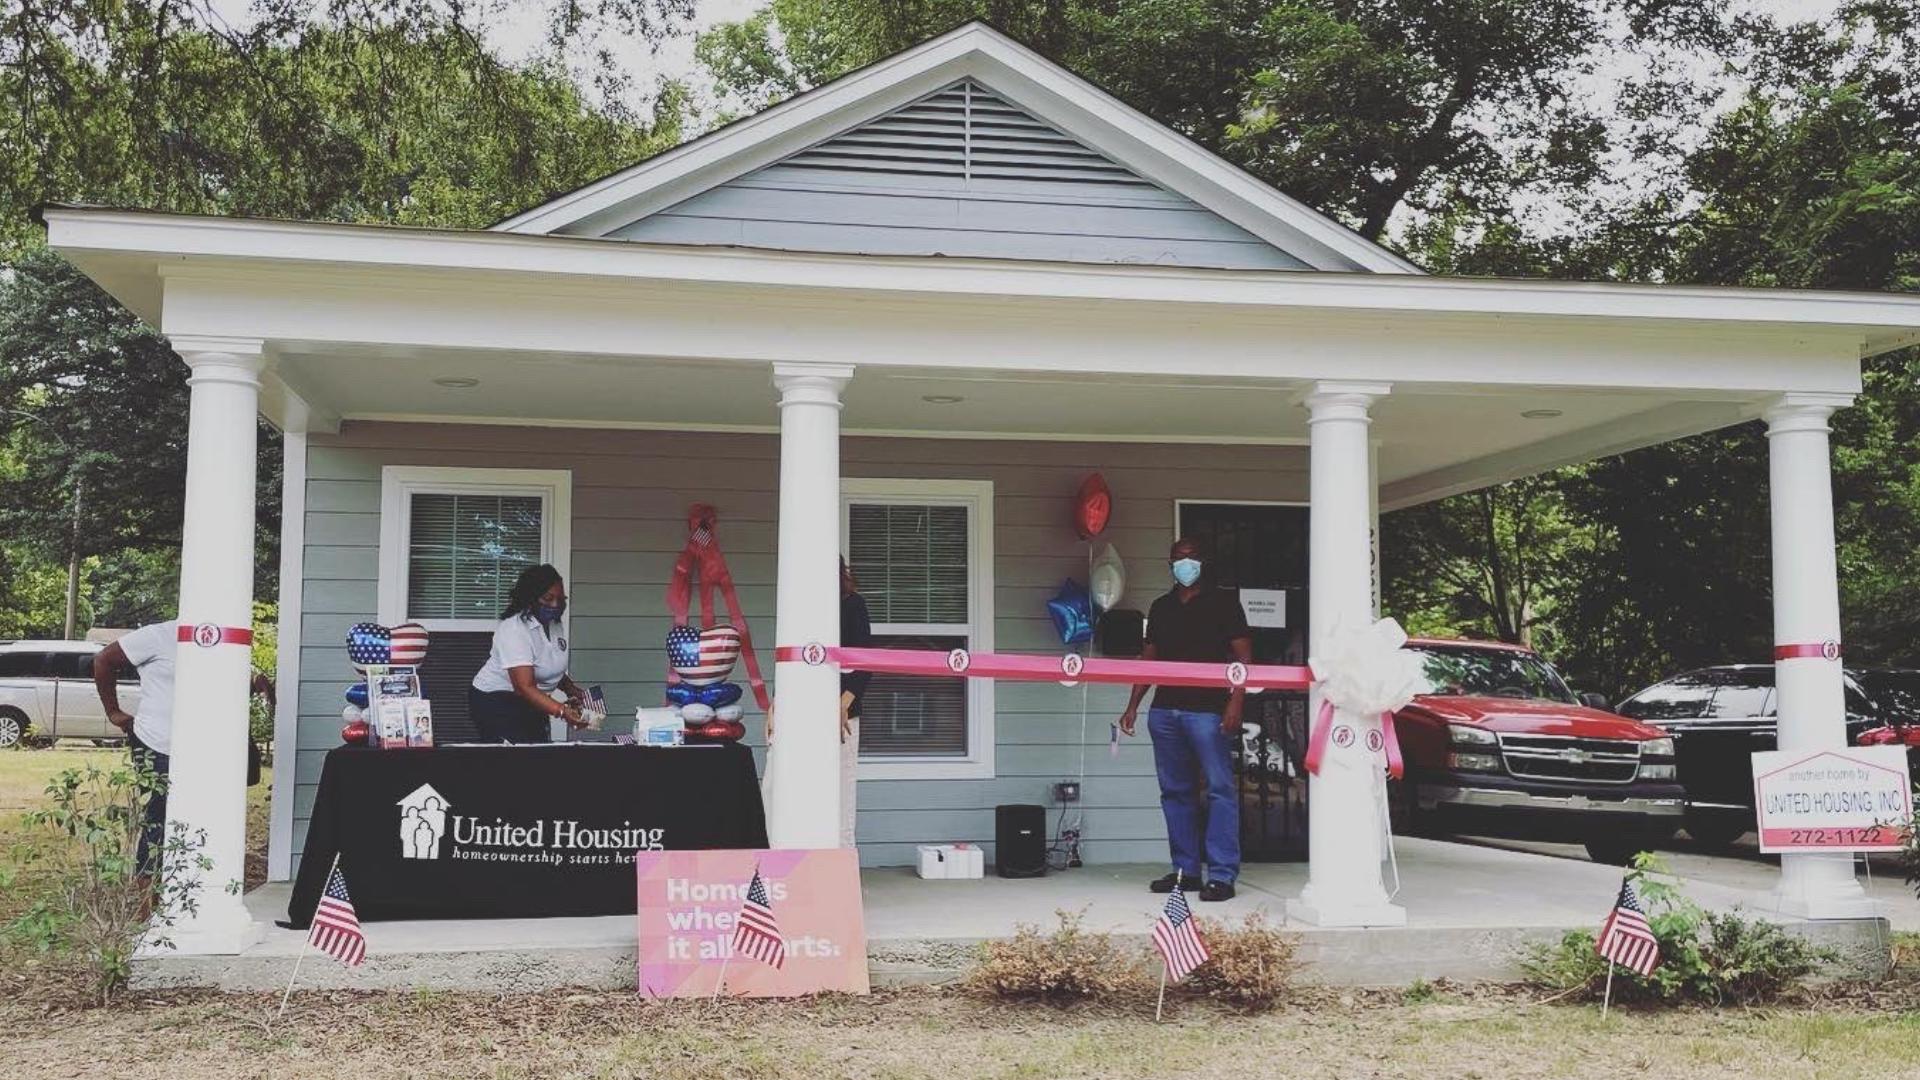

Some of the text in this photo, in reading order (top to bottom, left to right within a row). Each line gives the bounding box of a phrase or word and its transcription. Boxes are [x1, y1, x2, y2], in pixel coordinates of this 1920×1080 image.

[1766, 792, 1811, 814] UNITED
[452, 815, 664, 851] United Housing
[1790, 829, 1882, 844] 272-1122
[452, 846, 637, 865] homeownership starts her
[763, 877, 788, 900] is
[667, 905, 741, 931] wher
[668, 935, 690, 959] it
[700, 934, 734, 959] all
